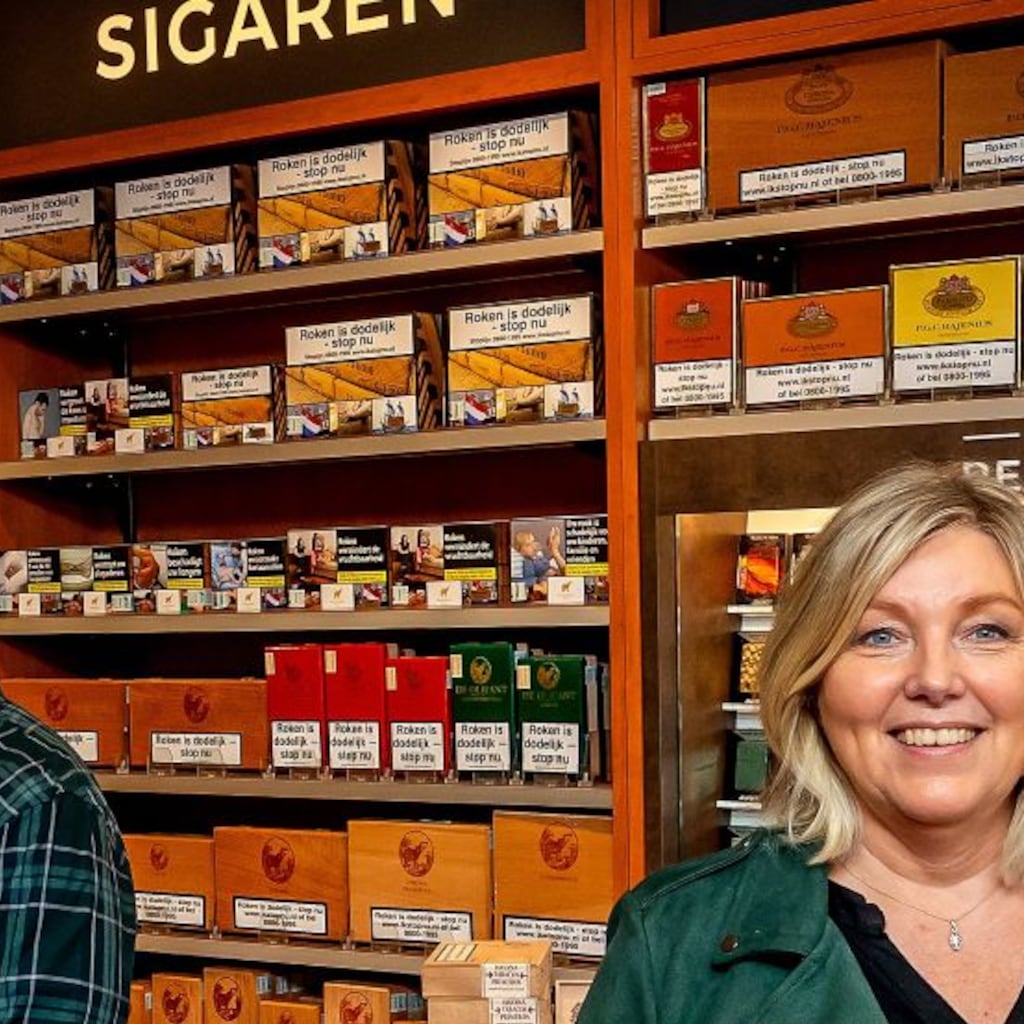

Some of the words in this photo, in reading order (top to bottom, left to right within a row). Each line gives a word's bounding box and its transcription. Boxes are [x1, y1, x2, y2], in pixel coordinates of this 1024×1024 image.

[444, 132, 482, 147] Roken
[487, 128, 497, 141] is
[501, 119, 549, 138] dodelijk
[479, 138, 506, 154] stop
[510, 136, 526, 148] nu
[272, 158, 306, 172] Roken
[309, 156, 319, 168] is
[322, 145, 367, 164] dodelijk
[305, 165, 328, 181] stop
[332, 164, 345, 175] nu
[464, 310, 503, 324] Roken
[507, 307, 518, 320] is
[522, 302, 571, 320] dodelijk
[300, 327, 335, 341] Roken
[337, 325, 348, 338] is
[350, 320, 396, 338] dodelijk
[499, 319, 527, 335] stop
[531, 317, 547, 329] nu
[332, 336, 357, 351] stop
[360, 335, 373, 346] nu
[461, 724, 492, 735] Roken
[495, 725, 503, 735] is
[530, 724, 560, 736] Roken
[563, 725, 572, 736] is
[458, 738, 495, 749] dodelijk
[524, 738, 564, 752] dodelijk
[465, 752, 486, 764] stop
[488, 753, 502, 762] nu
[532, 753, 553, 765] stop
[556, 755, 570, 765] nu
